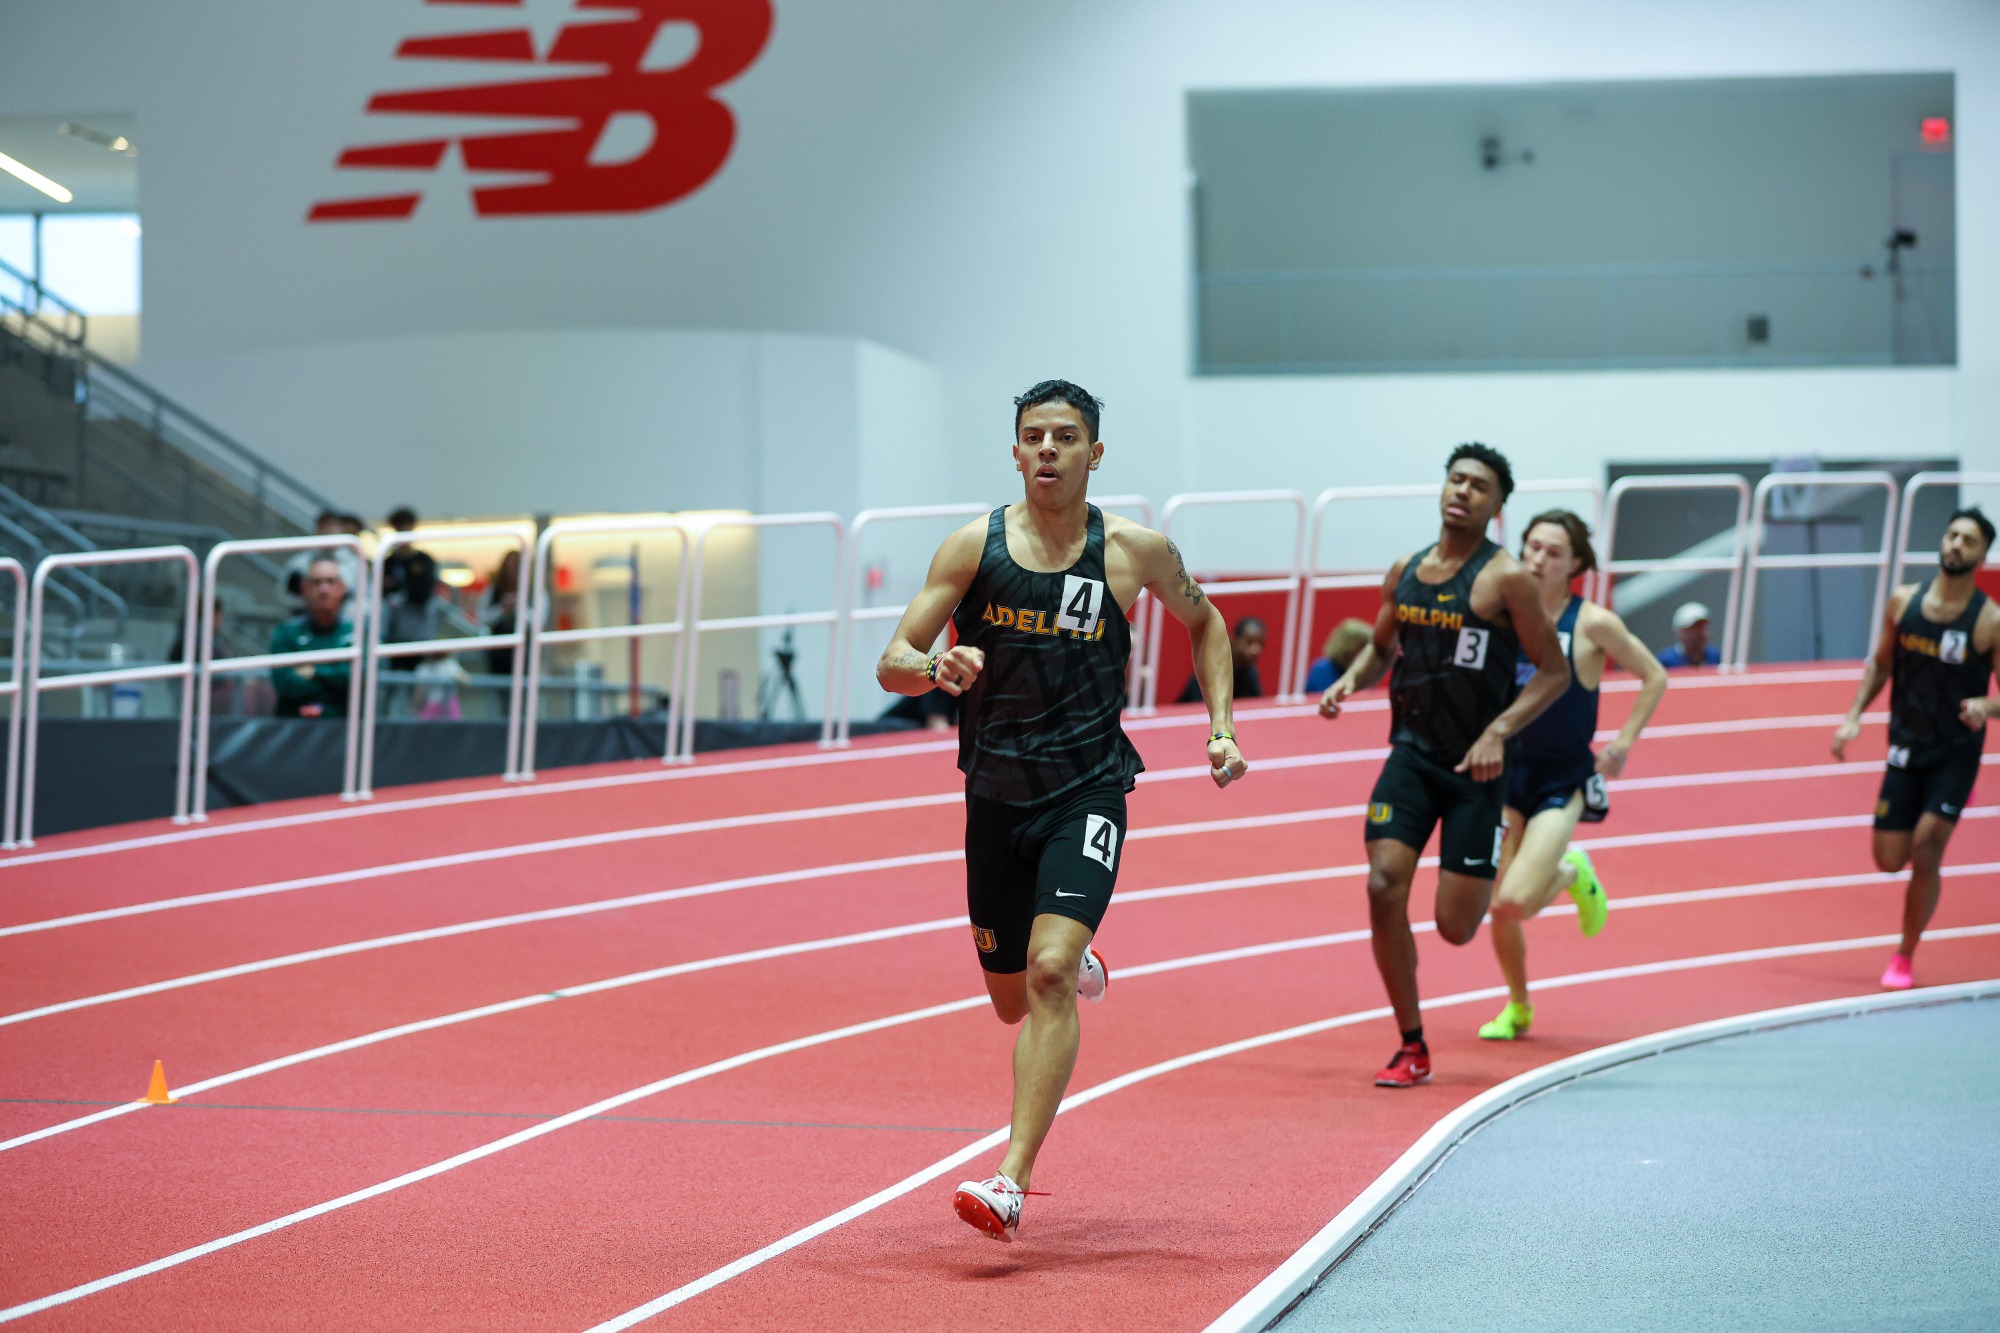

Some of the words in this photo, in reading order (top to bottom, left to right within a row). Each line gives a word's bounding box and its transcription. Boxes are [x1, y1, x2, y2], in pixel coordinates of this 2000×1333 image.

[1066, 582, 1093, 629] 4
[1395, 603, 1464, 631] DELPHI
[1461, 630, 1481, 664] 3
[1945, 631, 1961, 663] 2
[1090, 820, 1112, 864] 4
